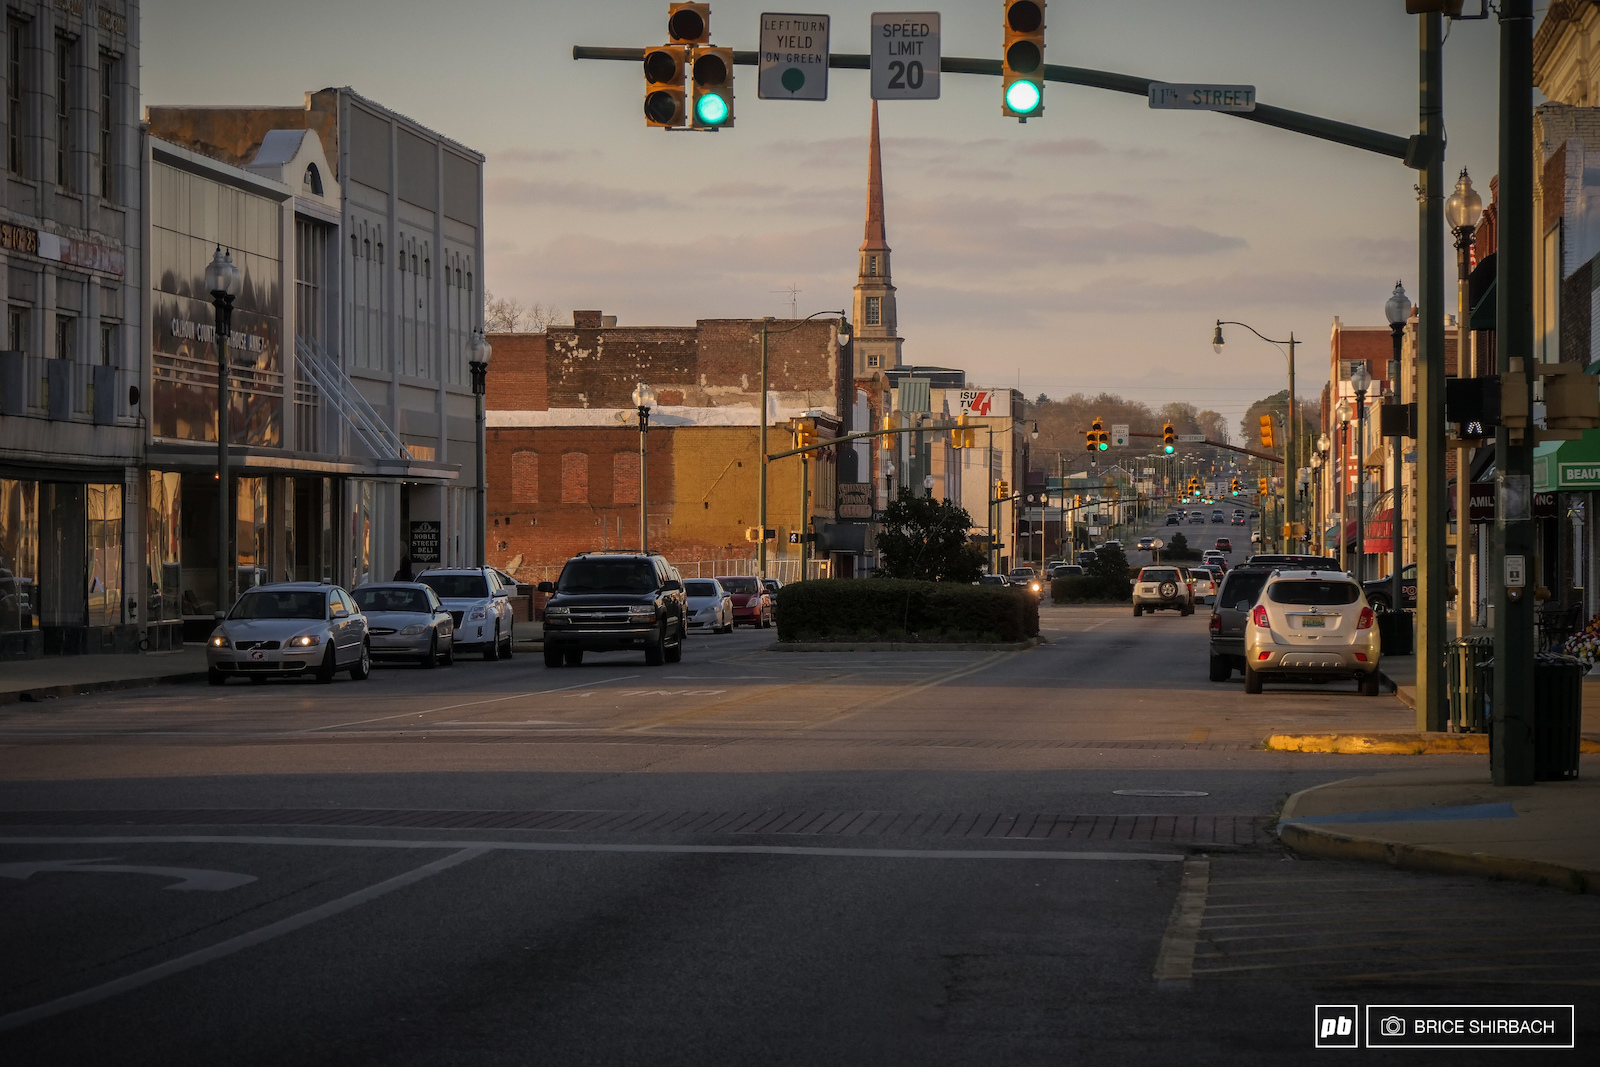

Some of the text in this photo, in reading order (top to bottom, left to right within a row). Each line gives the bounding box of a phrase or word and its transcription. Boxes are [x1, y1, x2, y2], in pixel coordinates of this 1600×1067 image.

[765, 20, 825, 32] LEFT TURN
[883, 23, 930, 38] SPEED
[777, 35, 812, 49] YIELD
[889, 41, 924, 56] LIMIT
[766, 53, 822, 63] ON GREEN
[888, 60, 924, 90] 20
[1151, 88, 1252, 106] 11TH STREET
[960, 400, 974, 408] TV
